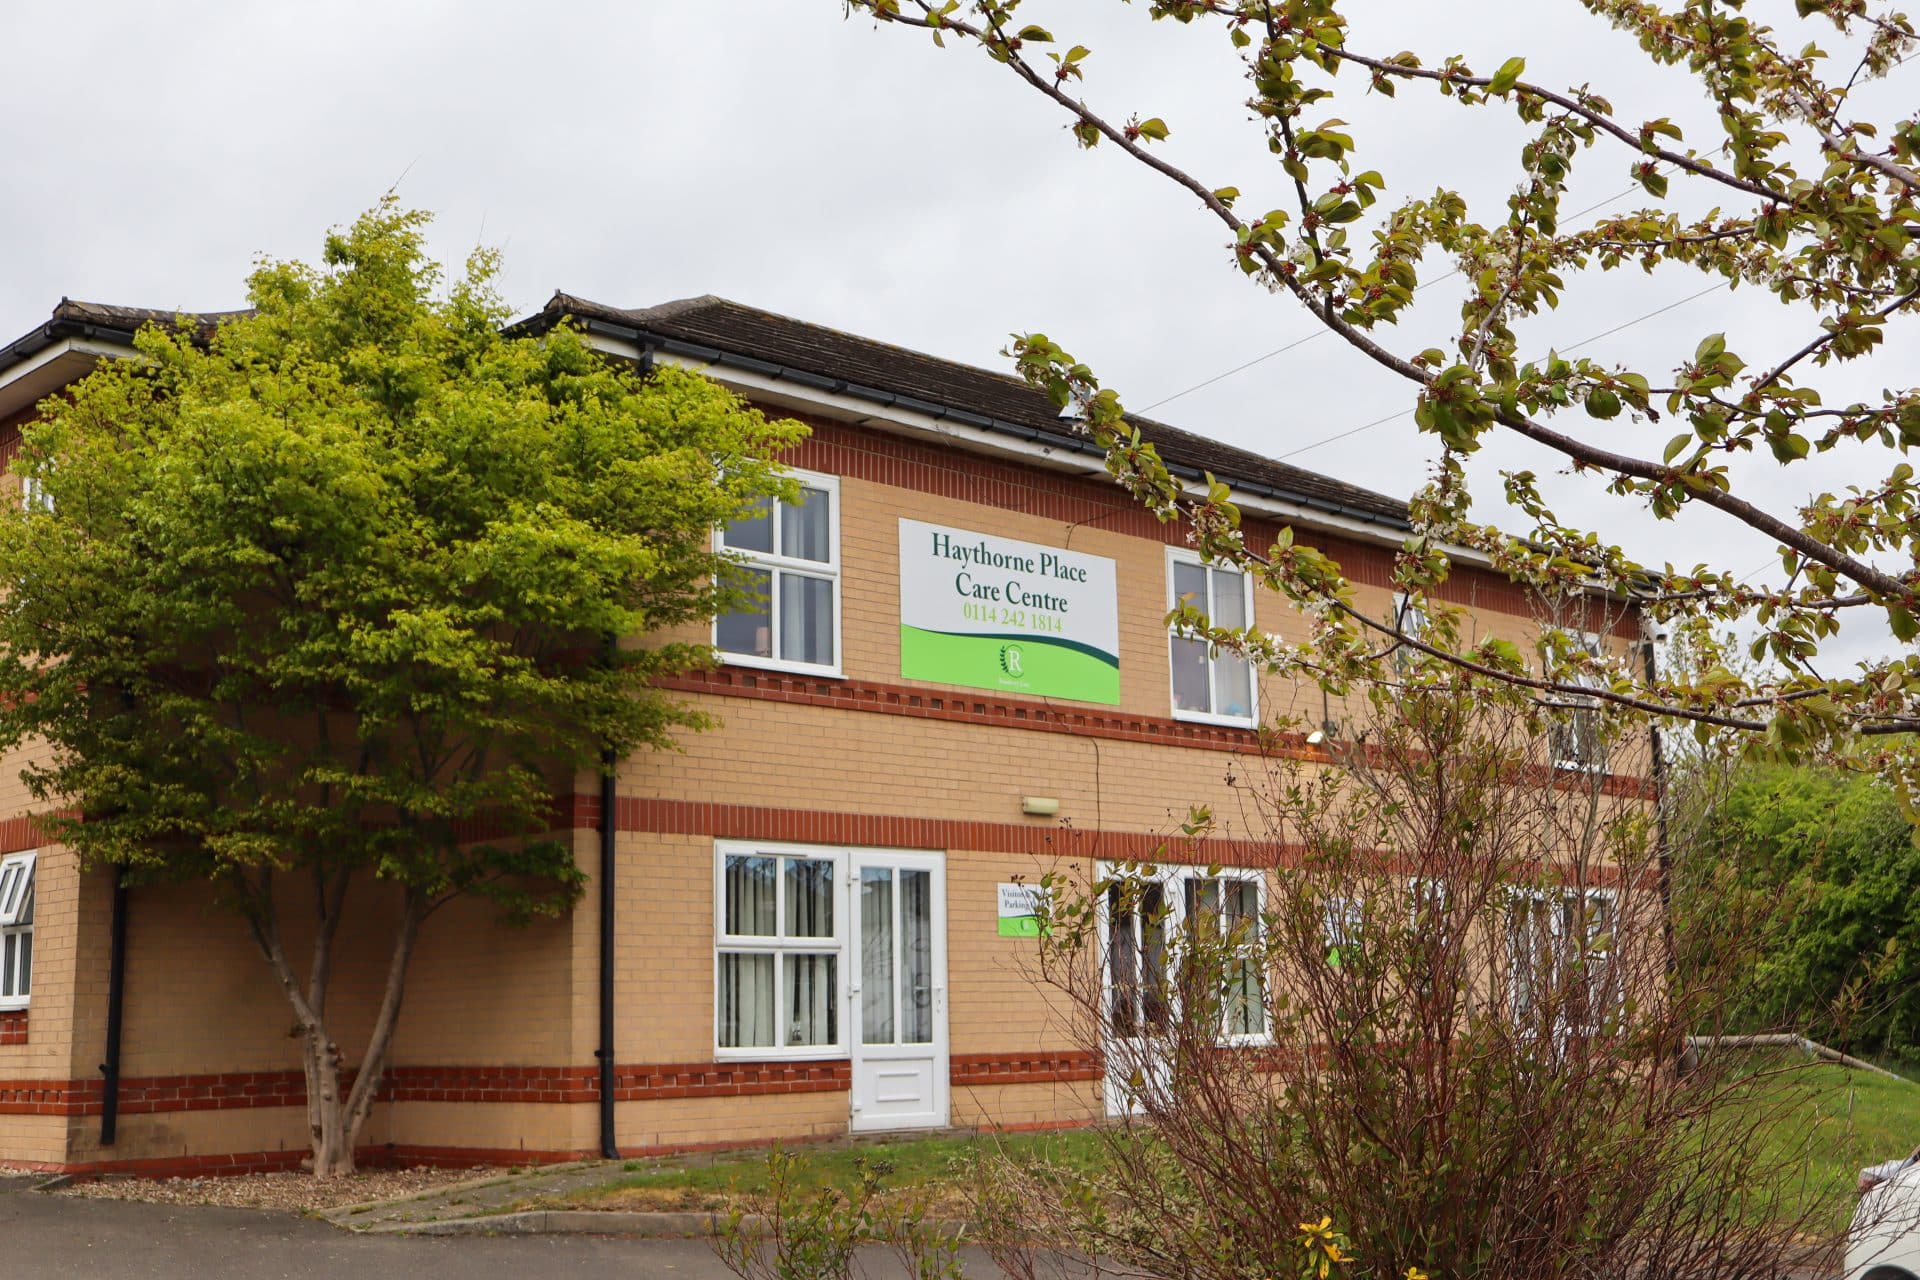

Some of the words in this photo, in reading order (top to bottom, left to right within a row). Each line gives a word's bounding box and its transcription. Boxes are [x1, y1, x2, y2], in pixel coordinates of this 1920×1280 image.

[932, 532, 1035, 573] Haythorne
[1040, 552, 1087, 583] Place
[955, 572, 1000, 602] Care
[1005, 581, 1068, 613] Centre
[963, 602, 997, 622] 0114
[1001, 608, 1025, 627] 242
[1031, 613, 1063, 632] 1814
[1008, 650, 1022, 672] R
